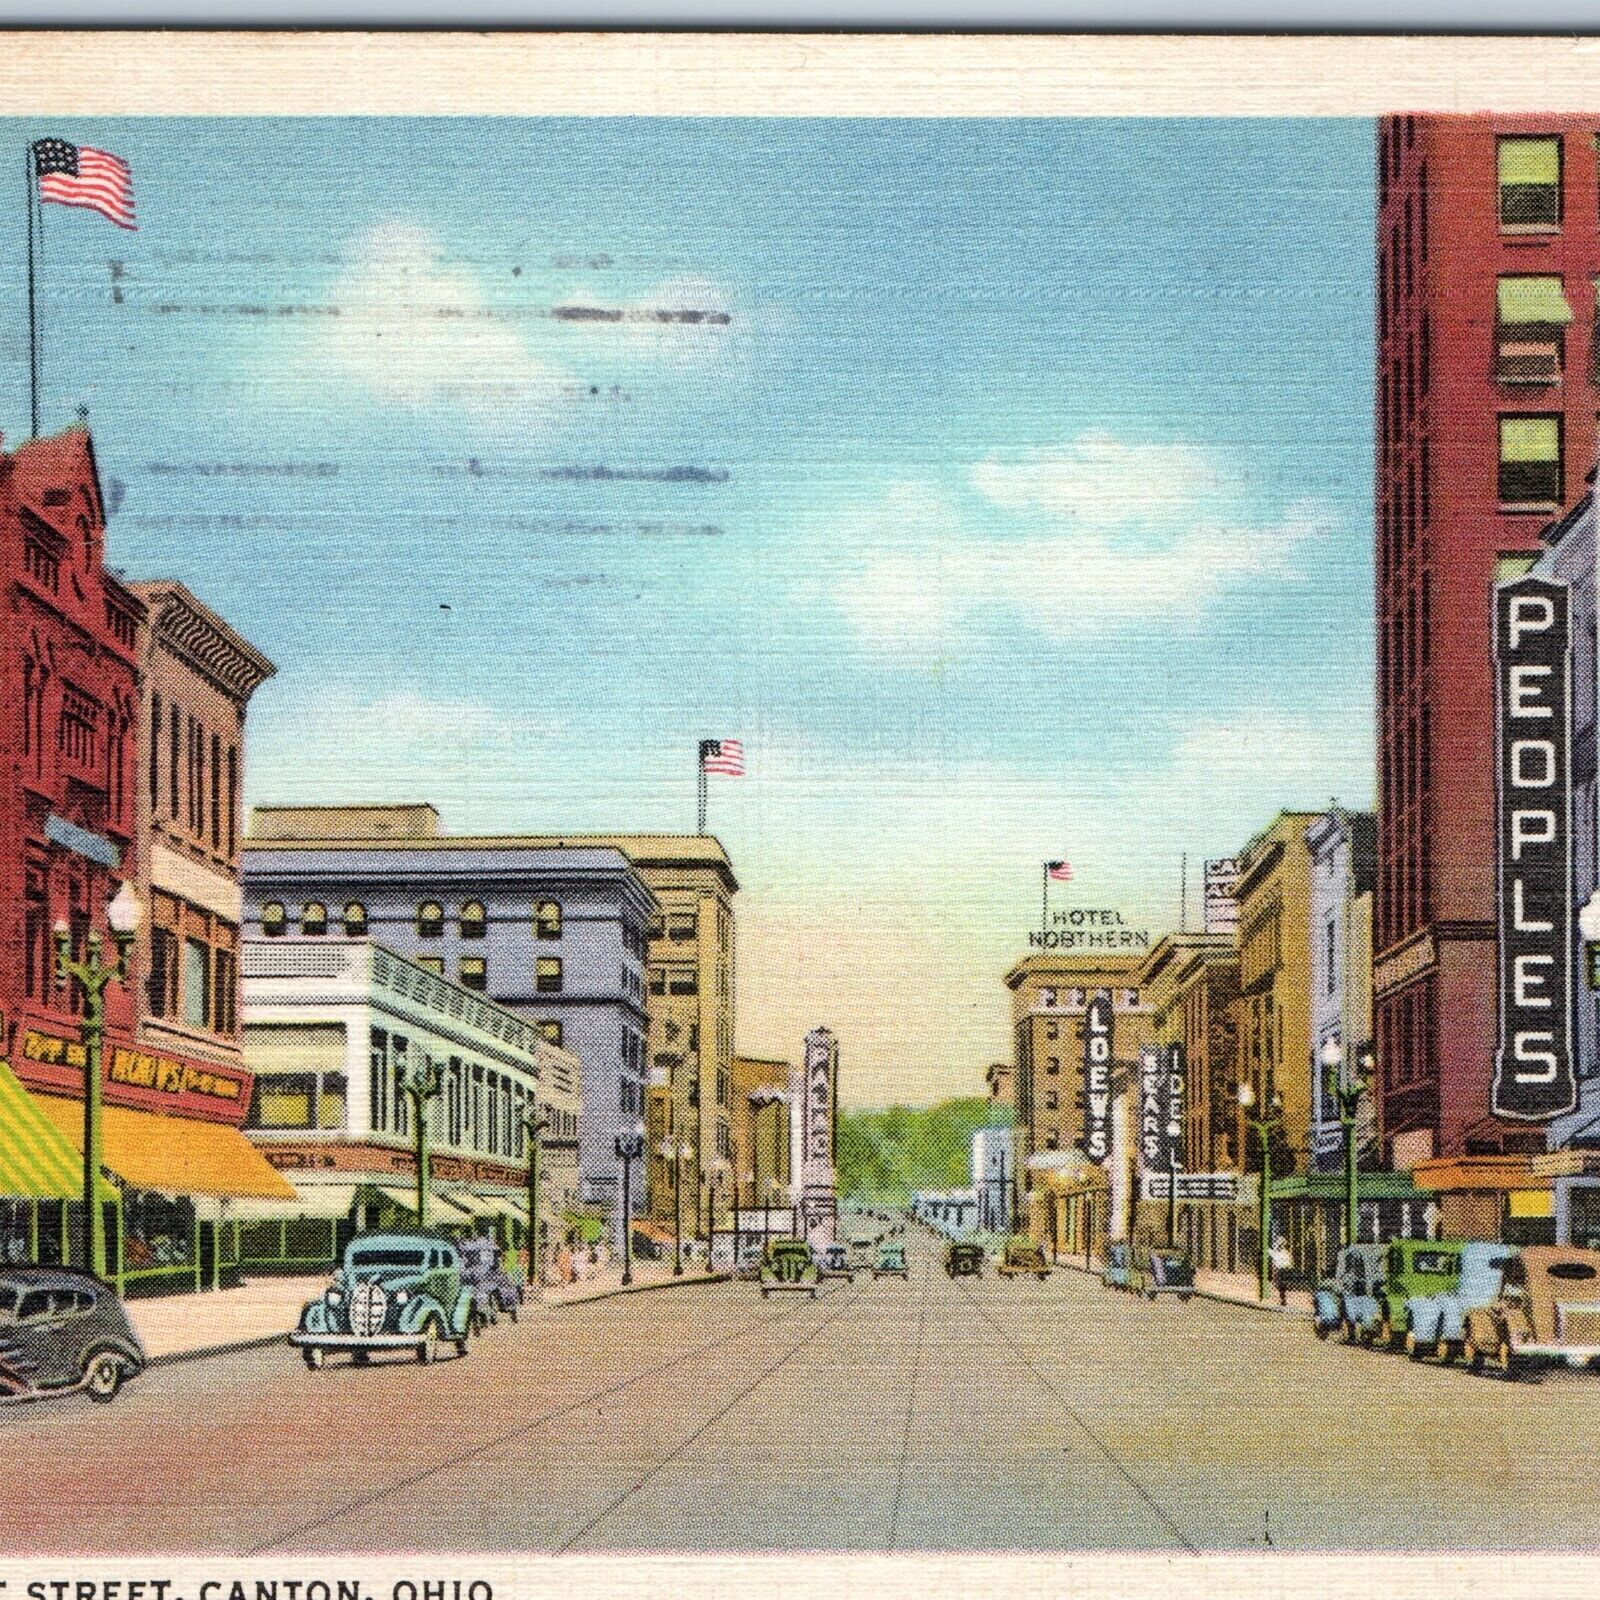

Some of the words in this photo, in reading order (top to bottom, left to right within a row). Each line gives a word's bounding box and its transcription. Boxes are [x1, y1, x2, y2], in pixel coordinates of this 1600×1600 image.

[1508, 596, 1557, 1084] PEOPLES
[1052, 909, 1125, 926] HOTEL
[393, 1581, 493, 1600] OHIO
